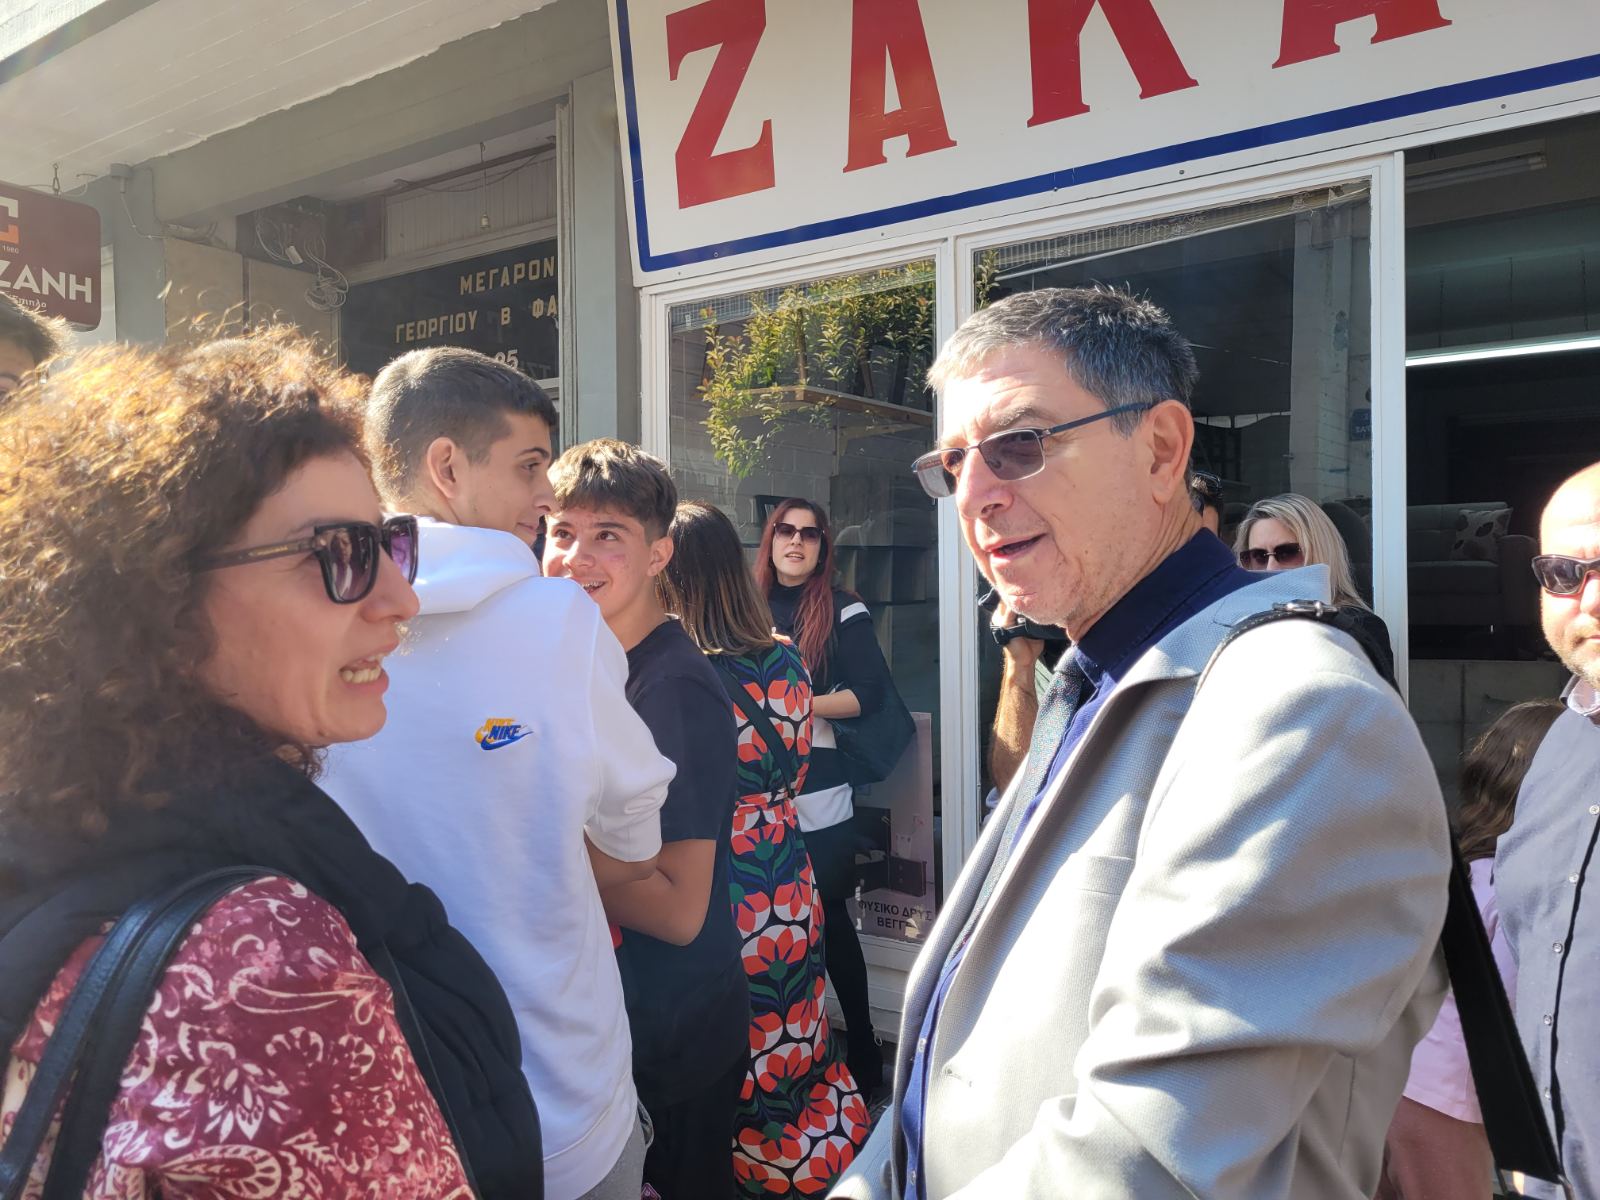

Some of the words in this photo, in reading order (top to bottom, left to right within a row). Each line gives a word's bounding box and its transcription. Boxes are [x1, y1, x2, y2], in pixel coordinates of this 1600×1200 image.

[459, 256, 556, 296] ΜΕΓΑΡΟΝ
[395, 310, 478, 344] ΓΕΩΡΓΙΟΥ
[501, 307, 511, 326] Β
